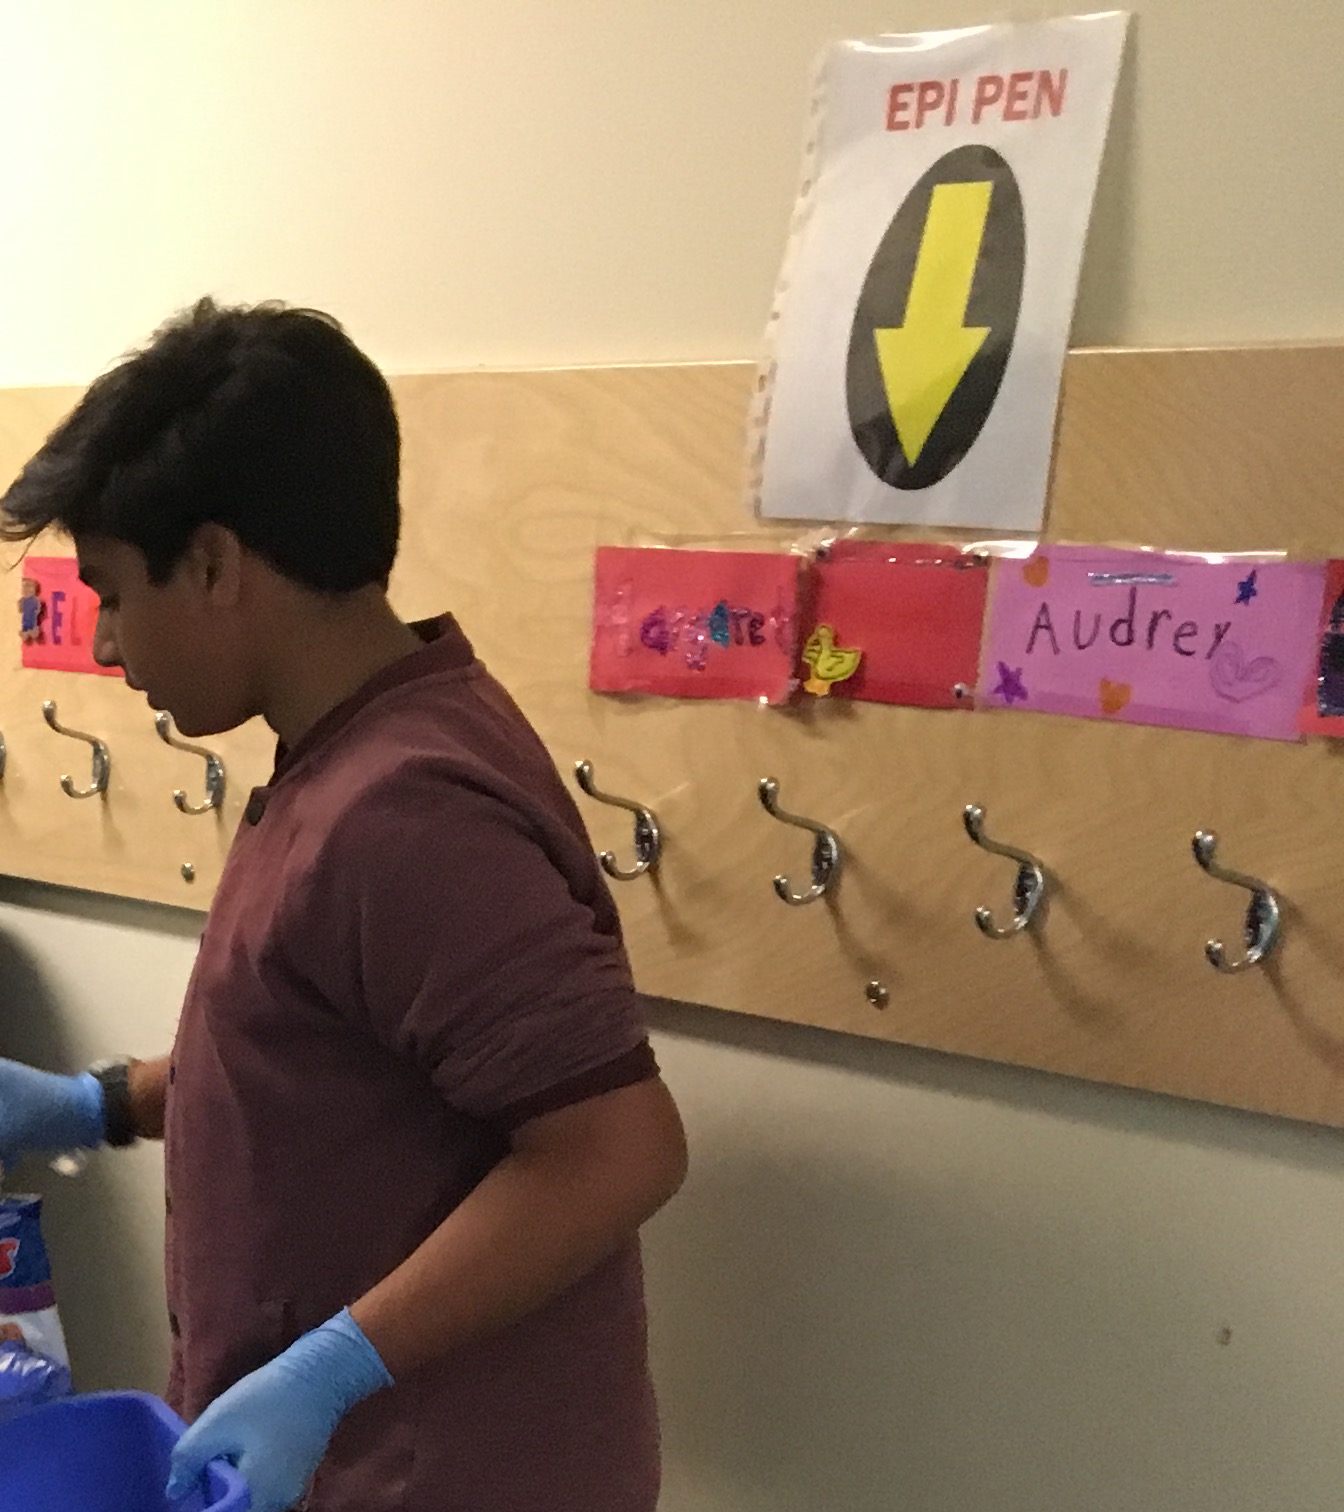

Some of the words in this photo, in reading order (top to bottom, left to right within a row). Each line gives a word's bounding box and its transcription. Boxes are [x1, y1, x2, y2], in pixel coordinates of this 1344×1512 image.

[885, 78, 959, 131] EPI
[971, 67, 1069, 126] PEN
[1025, 586, 1232, 660] Audrey
